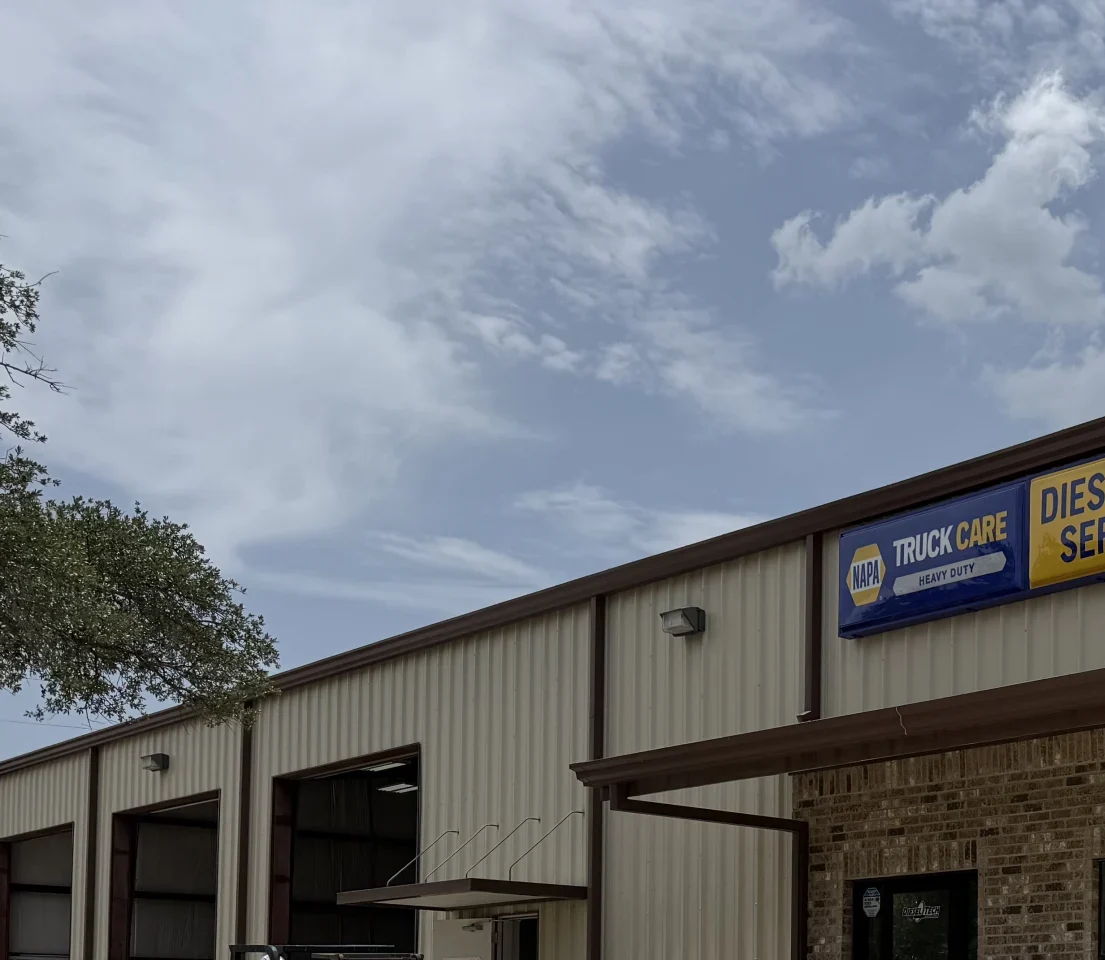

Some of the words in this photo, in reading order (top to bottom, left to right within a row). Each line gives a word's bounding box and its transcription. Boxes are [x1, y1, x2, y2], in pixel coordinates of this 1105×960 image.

[893, 524, 953, 567] TRUCK
[956, 511, 1008, 551] CARE
[852, 559, 880, 590] NAPA
[919, 569, 948, 587] HEAVY
[950, 563, 975, 580] DUTY
[924, 906, 941, 915] TECH
